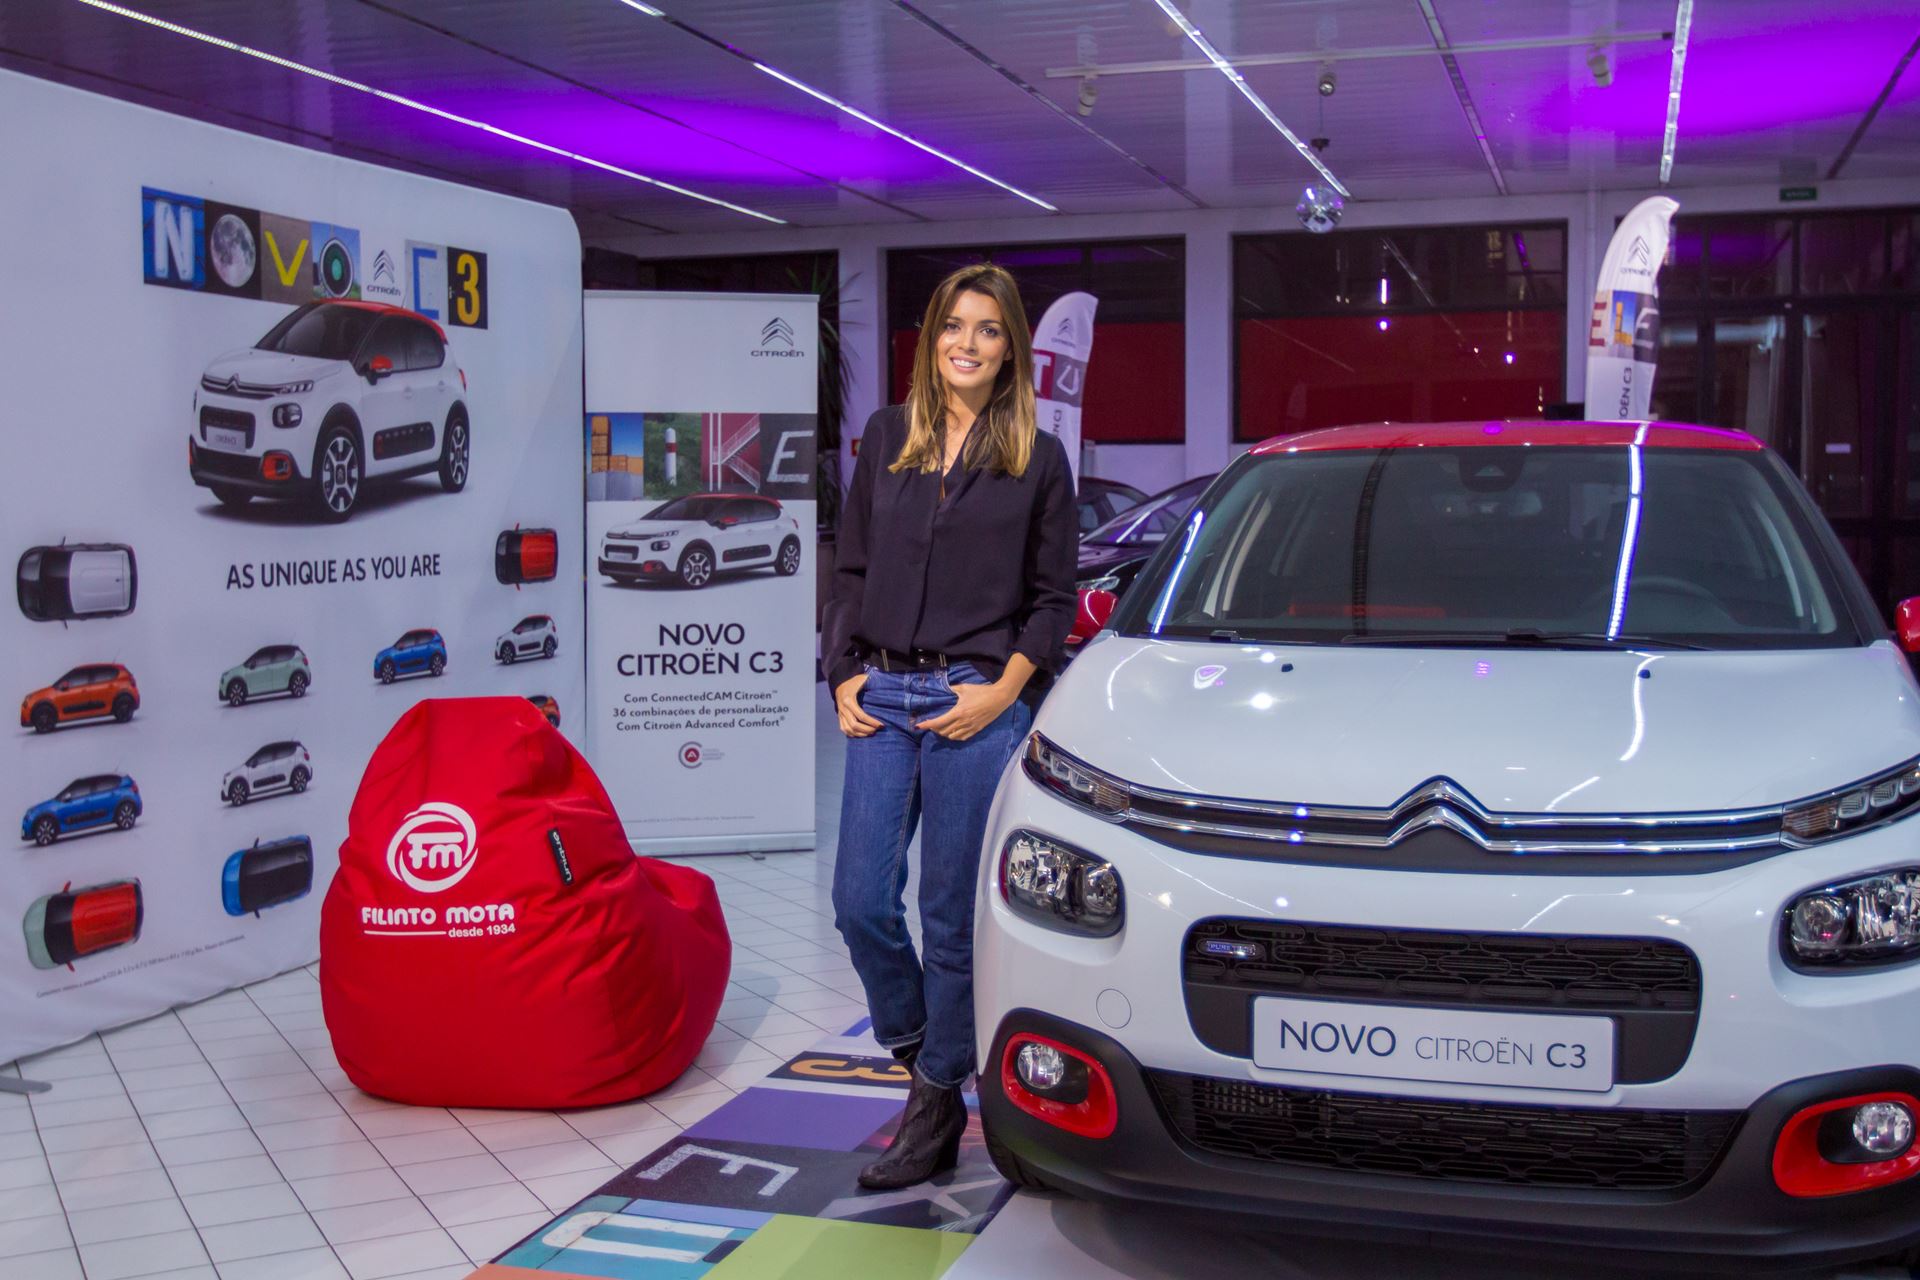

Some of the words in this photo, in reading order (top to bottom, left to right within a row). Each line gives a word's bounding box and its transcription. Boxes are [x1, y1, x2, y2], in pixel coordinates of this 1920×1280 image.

[153, 198, 353, 300] NOVO
[412, 247, 480, 326] C3
[591, 412, 815, 494] LIKE
[226, 564, 254, 590] AS
[261, 560, 337, 588] UNIQUE
[342, 558, 366, 582] AS
[371, 555, 406, 580] YOU
[410, 553, 441, 577] ARE
[659, 622, 745, 646] NOVO
[617, 647, 739, 676] CITROËN
[749, 651, 784, 674] C3
[624, 693, 648, 703] Com
[651, 691, 732, 702] ConnectedCAM
[613, 707, 627, 718] 36
[629, 704, 696, 717] combinações
[698, 704, 712, 716] de
[714, 703, 789, 720] personalização
[616, 721, 641, 731] Com
[643, 719, 682, 730] Citroën
[685, 718, 735, 729] Advanced
[362, 906, 437, 926] FILINTO
[445, 903, 515, 924] MOTA
[448, 926, 483, 938] desde
[487, 923, 516, 935] 1934
[1280, 1019, 1397, 1057] NOVO
[1415, 1036, 1533, 1066] CITROËN
[1546, 1043, 1586, 1069] C3
